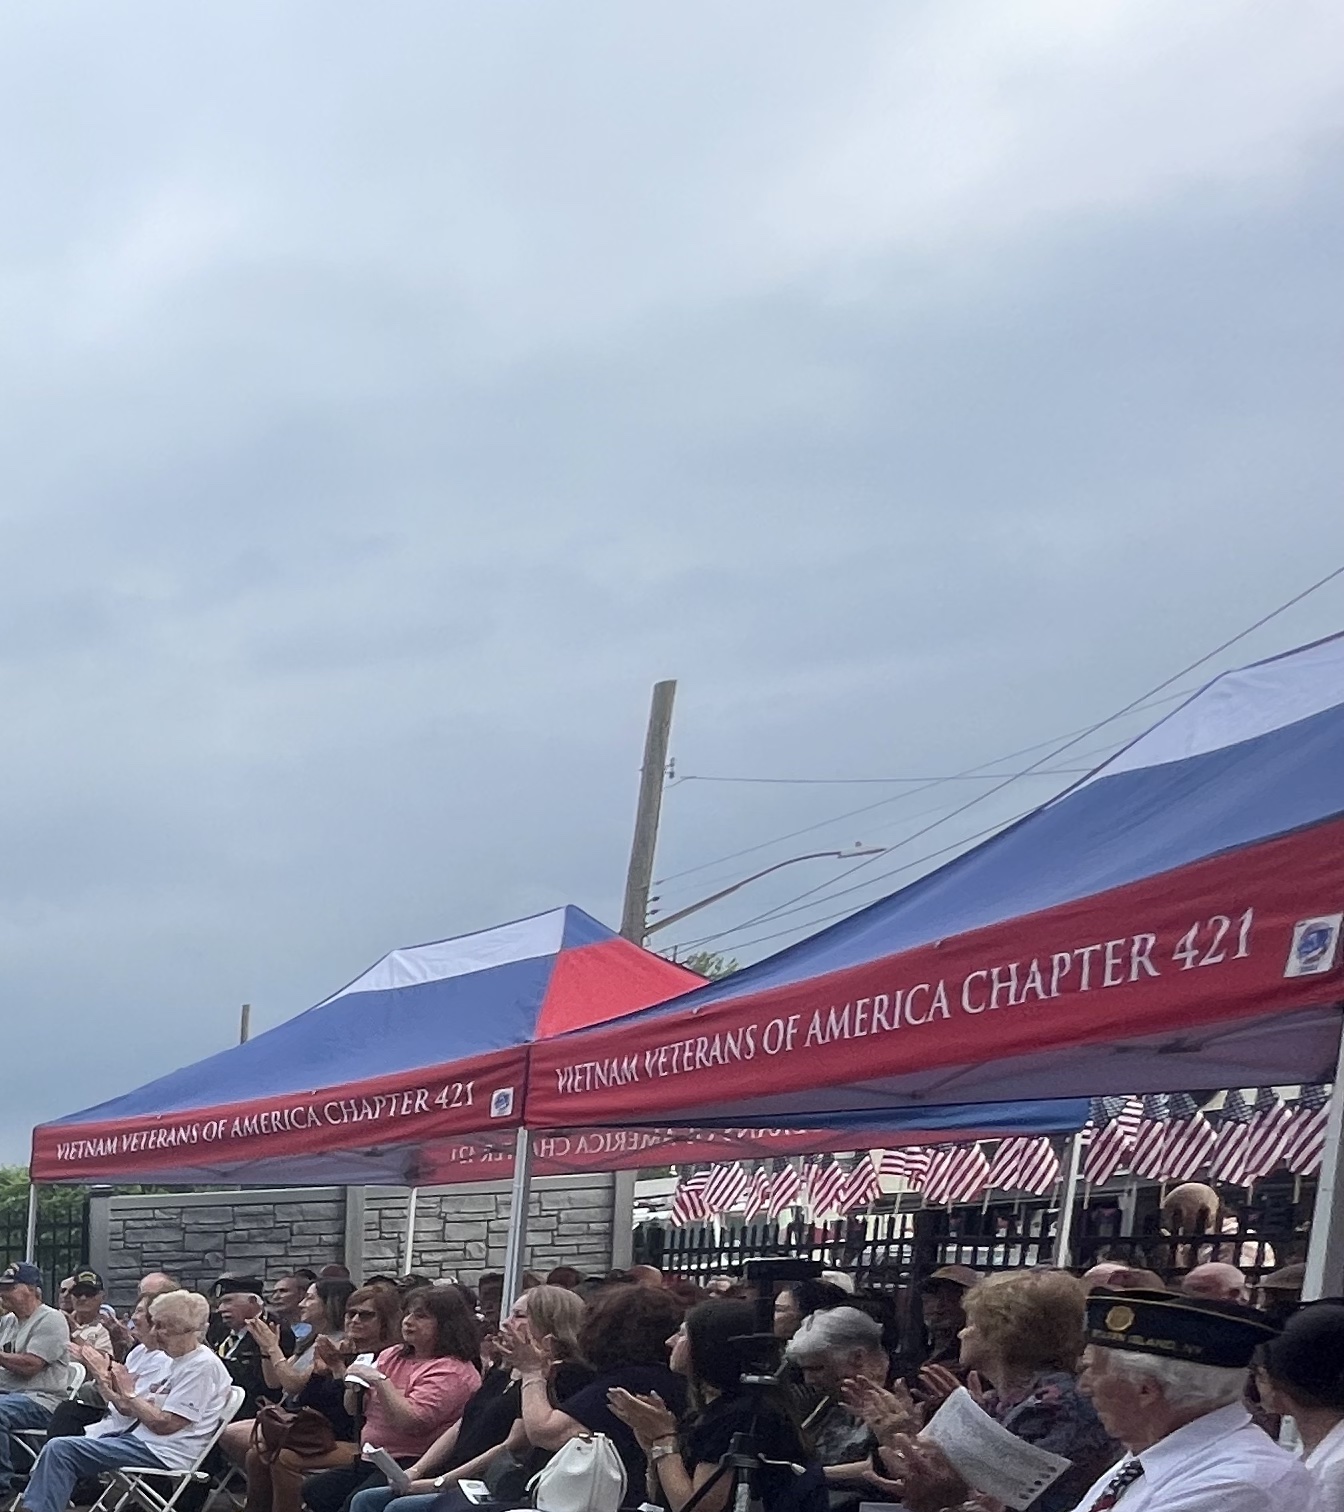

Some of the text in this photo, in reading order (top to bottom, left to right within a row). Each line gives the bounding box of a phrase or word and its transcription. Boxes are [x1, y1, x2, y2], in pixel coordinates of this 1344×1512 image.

[555, 906, 1255, 1094] VIETNAM VETERANS OF AMERICA CHAPTER 421
[56, 1080, 475, 1161] VIETNAM VETERANS OF AMERICA CHAPTER 421
